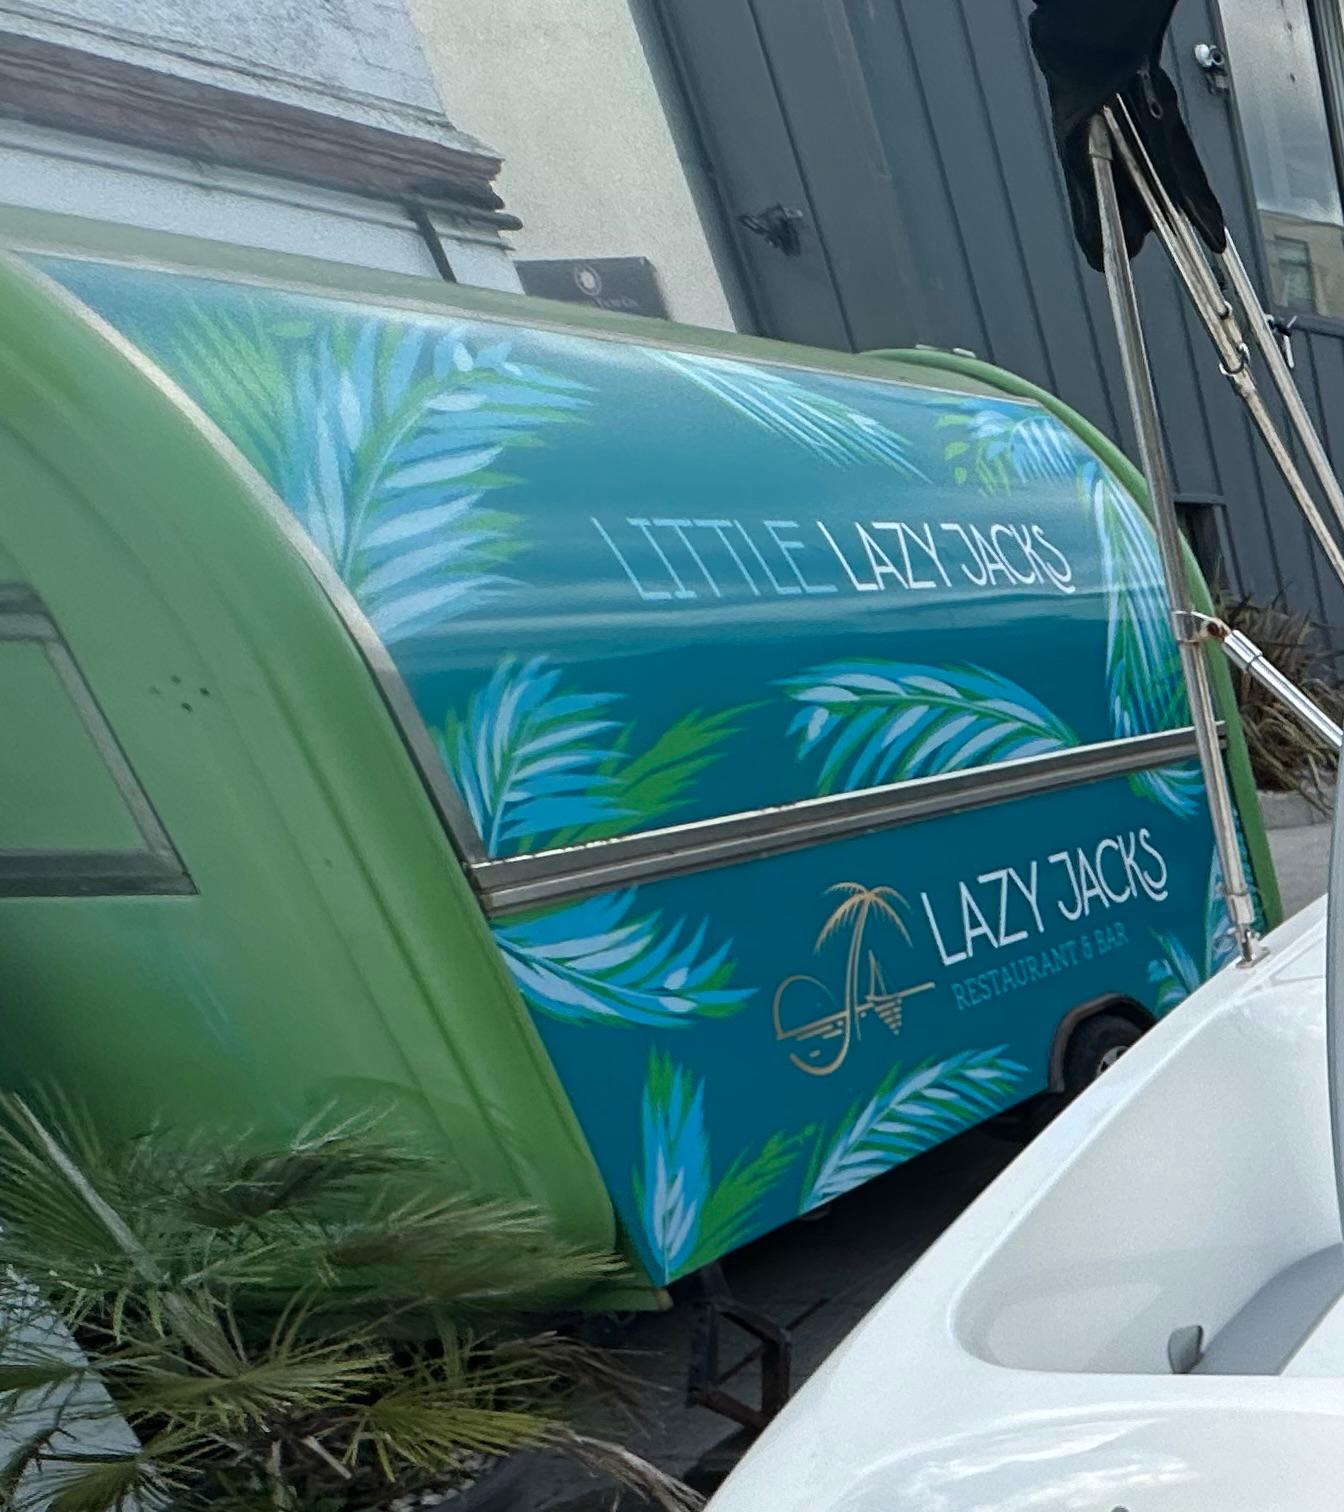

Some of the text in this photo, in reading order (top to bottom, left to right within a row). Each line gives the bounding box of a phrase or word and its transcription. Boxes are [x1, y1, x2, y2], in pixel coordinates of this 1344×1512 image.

[591, 516, 1076, 600] LITTLE LAZY JACKS
[920, 827, 1169, 967] LAZY JACKS
[951, 939, 1076, 1010] RESTAURANT
[1096, 921, 1130, 953] BAR
